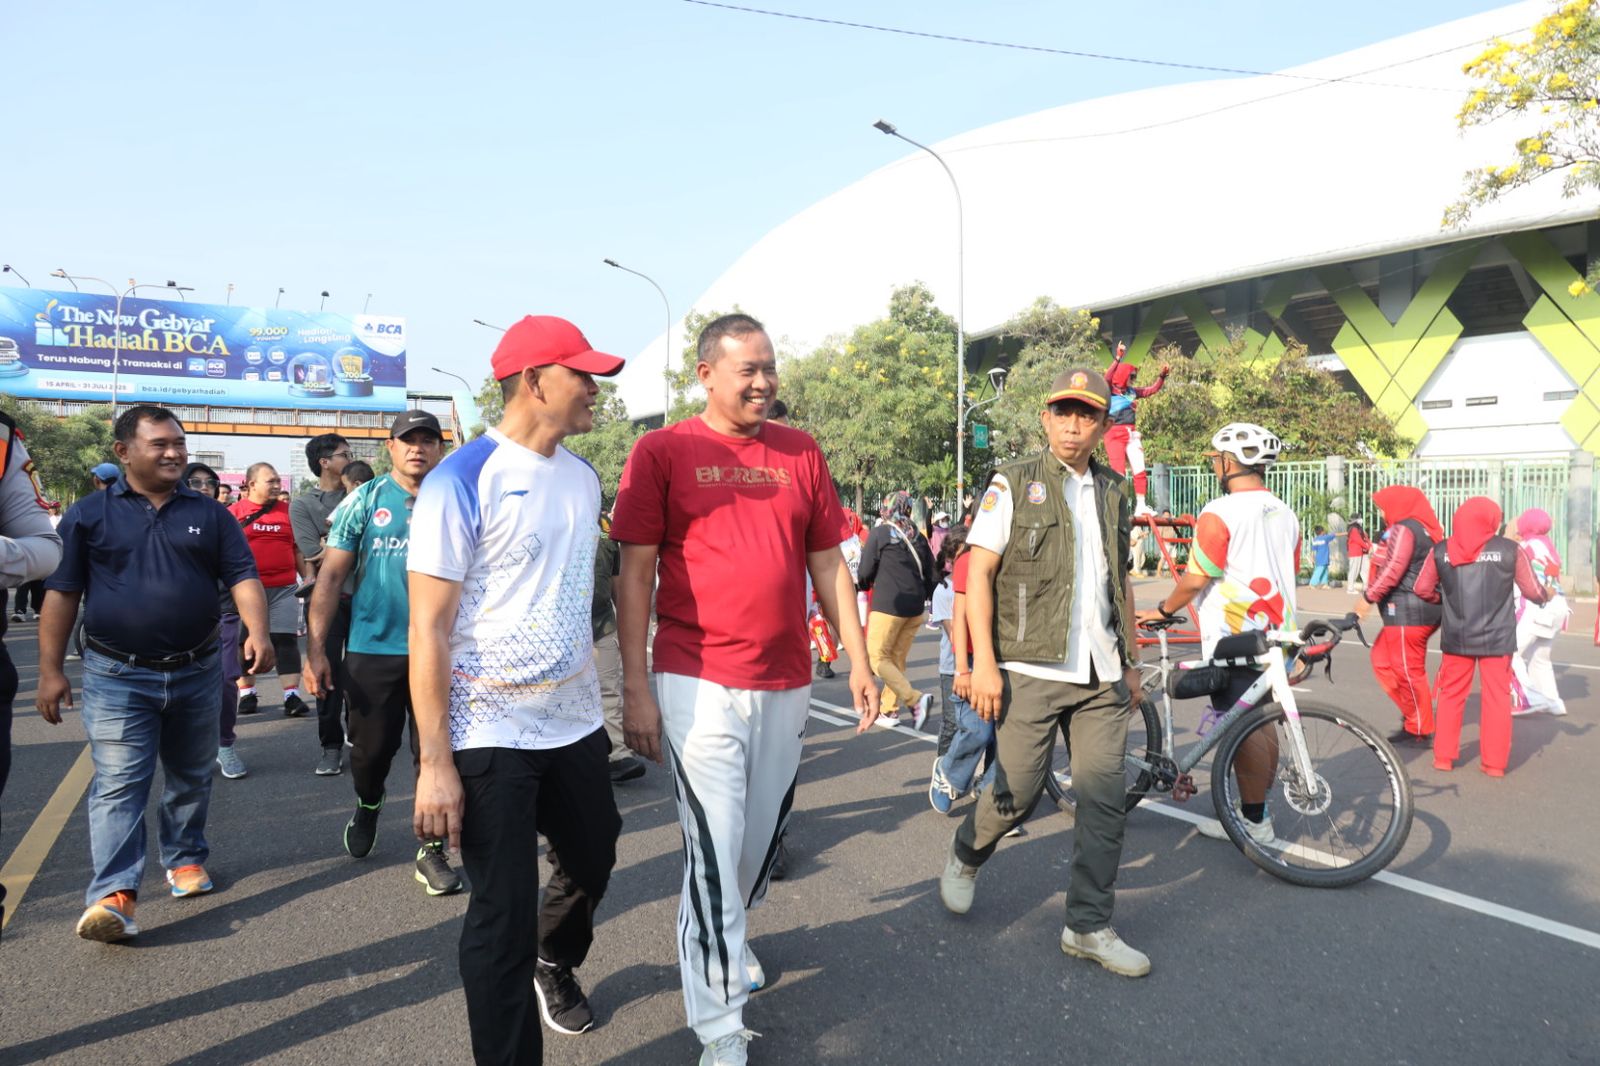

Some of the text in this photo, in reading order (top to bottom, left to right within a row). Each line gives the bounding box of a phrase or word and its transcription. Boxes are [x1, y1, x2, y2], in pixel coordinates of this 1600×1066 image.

[58, 305, 215, 337] The New Gebyar
[377, 323, 402, 335] BCA
[64, 324, 231, 355] Hadiah BCA
[37, 353, 67, 363] Terus
[69, 356, 110, 368] Nabung
[122, 359, 171, 370] Transaksi
[173, 361, 182, 370] di
[142, 385, 226, 395] bca.id/gebyarhadiah
[253, 522, 281, 532] RSPP
